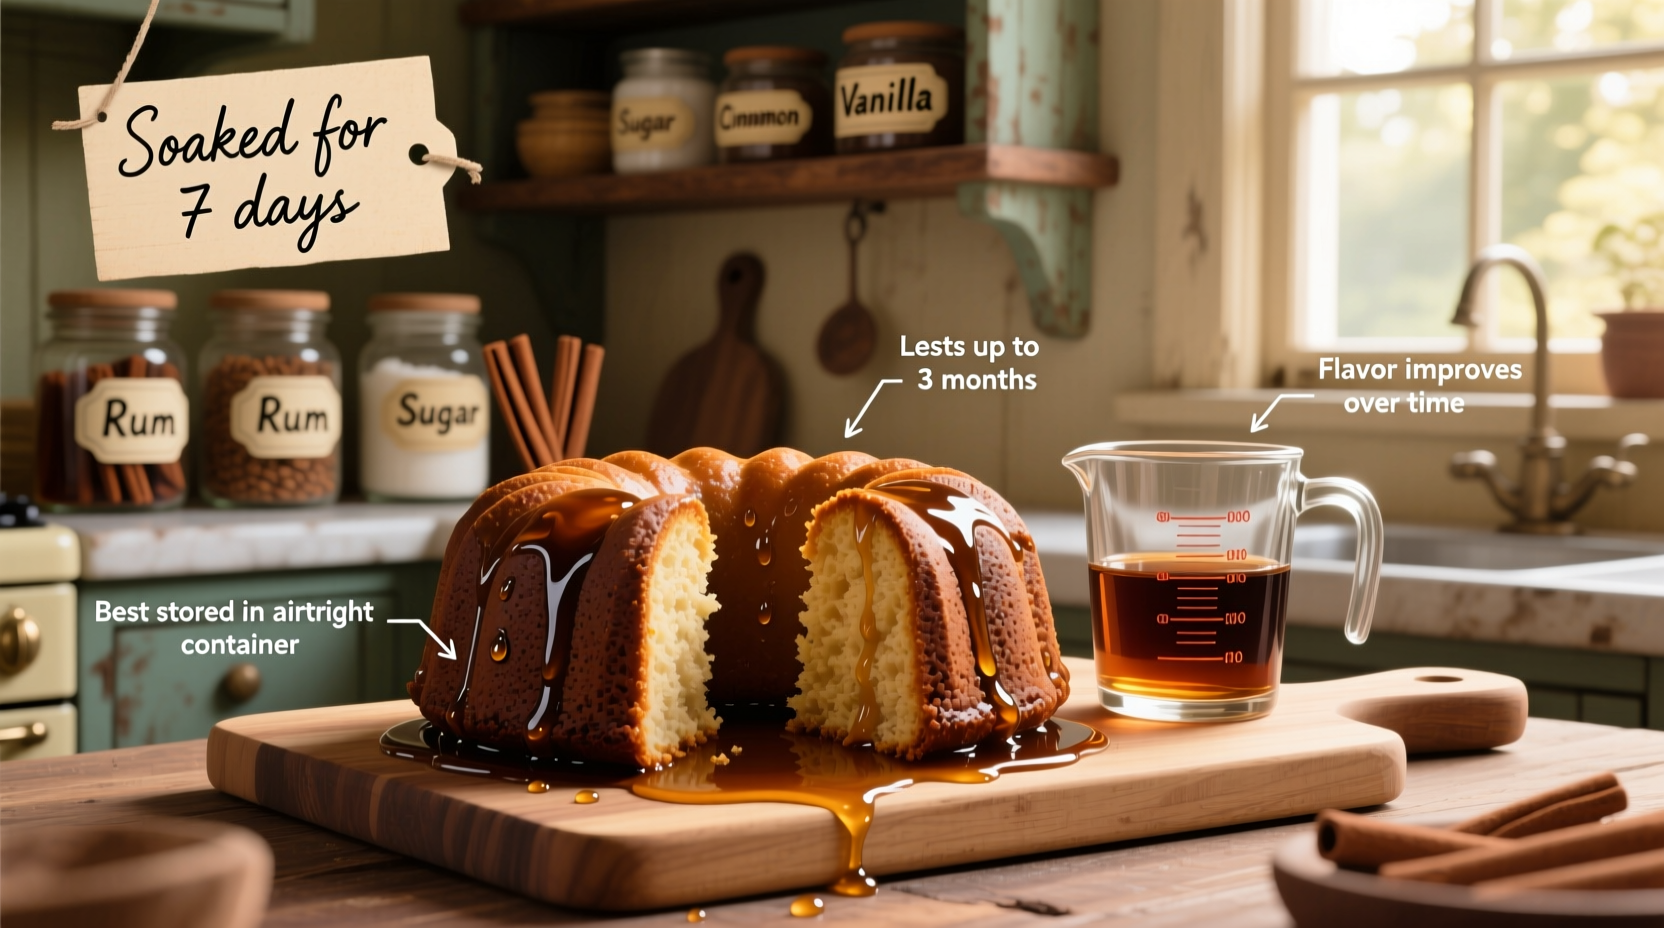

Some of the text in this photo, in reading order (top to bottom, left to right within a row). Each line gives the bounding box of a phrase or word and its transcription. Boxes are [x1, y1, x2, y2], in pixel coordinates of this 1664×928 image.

[841, 77, 933, 117] Vanilla
[118, 93, 388, 178] Soaked for
[617, 107, 676, 141] Sugar
[180, 172, 360, 253] 7 days
[103, 398, 176, 438] Rum
[256, 395, 329, 433] Rum
[396, 392, 480, 435] Sugar
